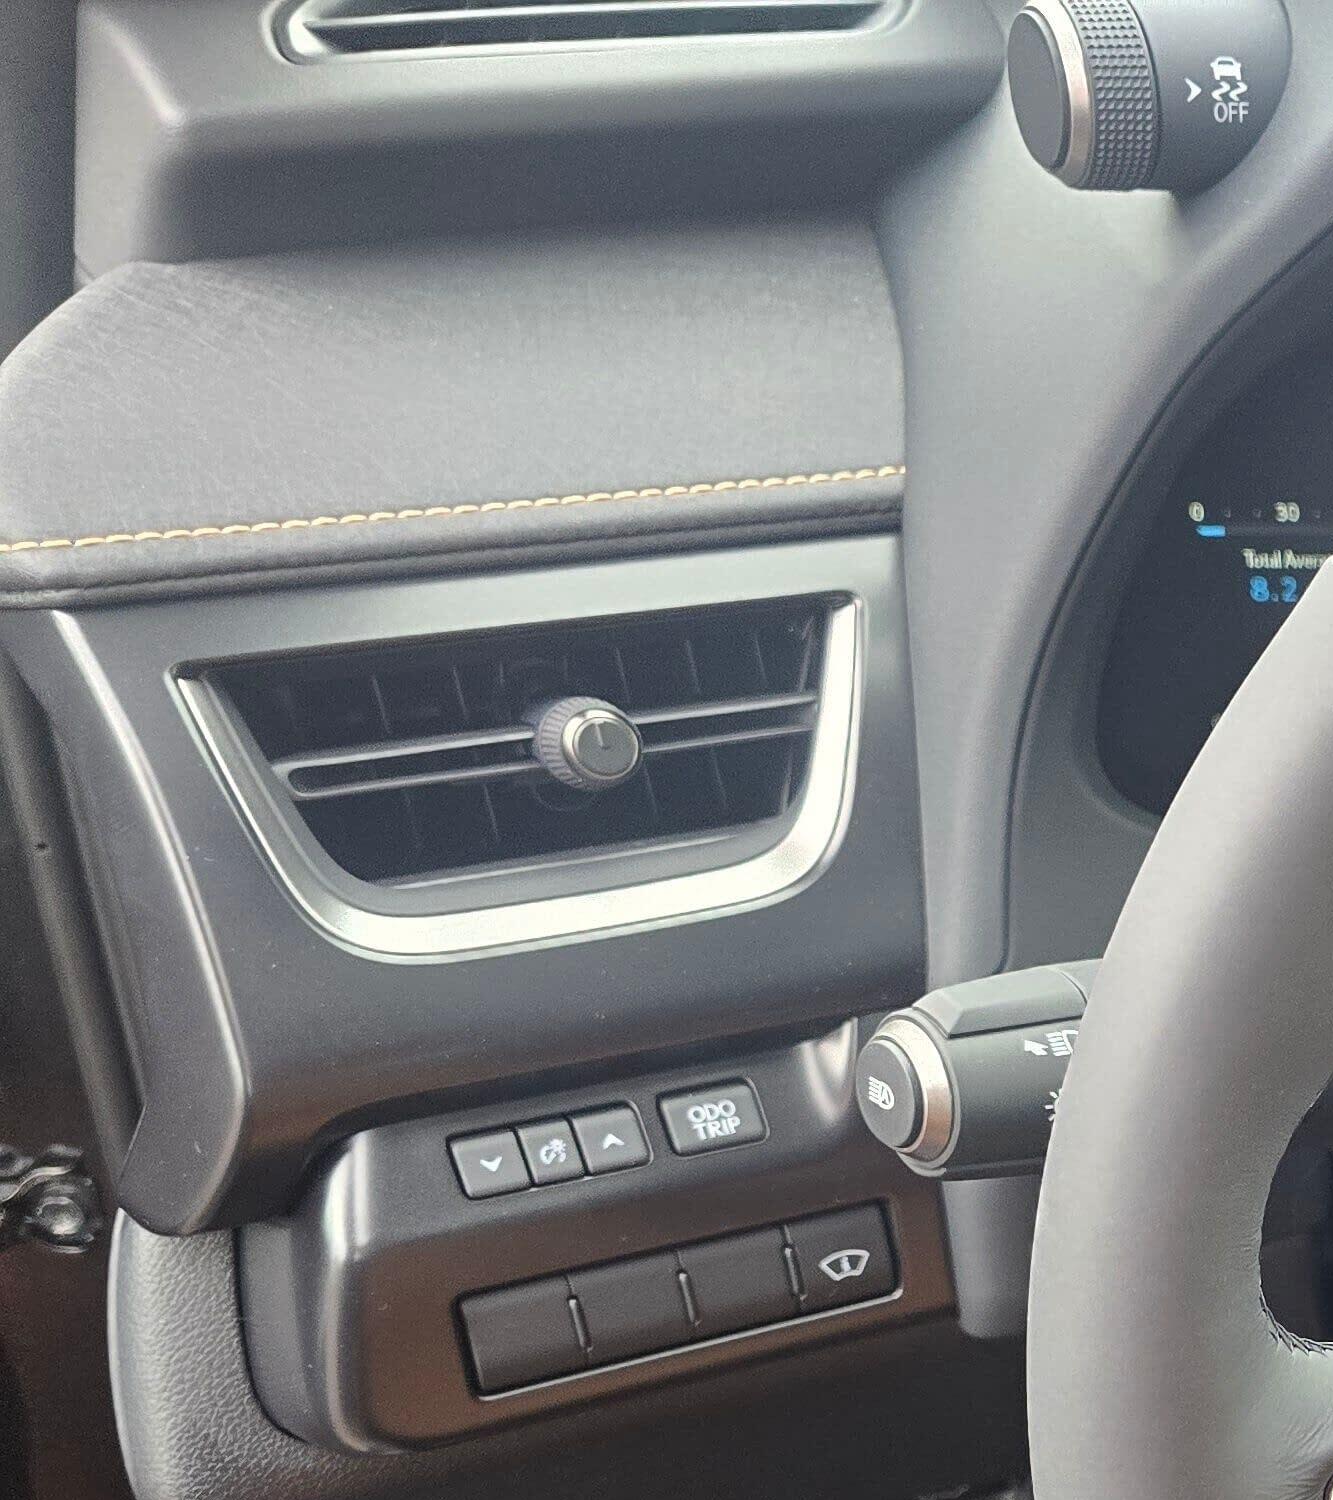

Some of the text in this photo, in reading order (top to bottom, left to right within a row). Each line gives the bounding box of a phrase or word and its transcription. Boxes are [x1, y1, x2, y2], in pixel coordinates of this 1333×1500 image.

[1213, 101, 1250, 123] OFF
[1188, 502, 1205, 522] 0
[1274, 502, 1300, 522] 30
[1241, 548, 1282, 569] Total
[1249, 575, 1297, 602] 8.2
[687, 1099, 737, 1123] ODO
[692, 1115, 741, 1140] TRIP
